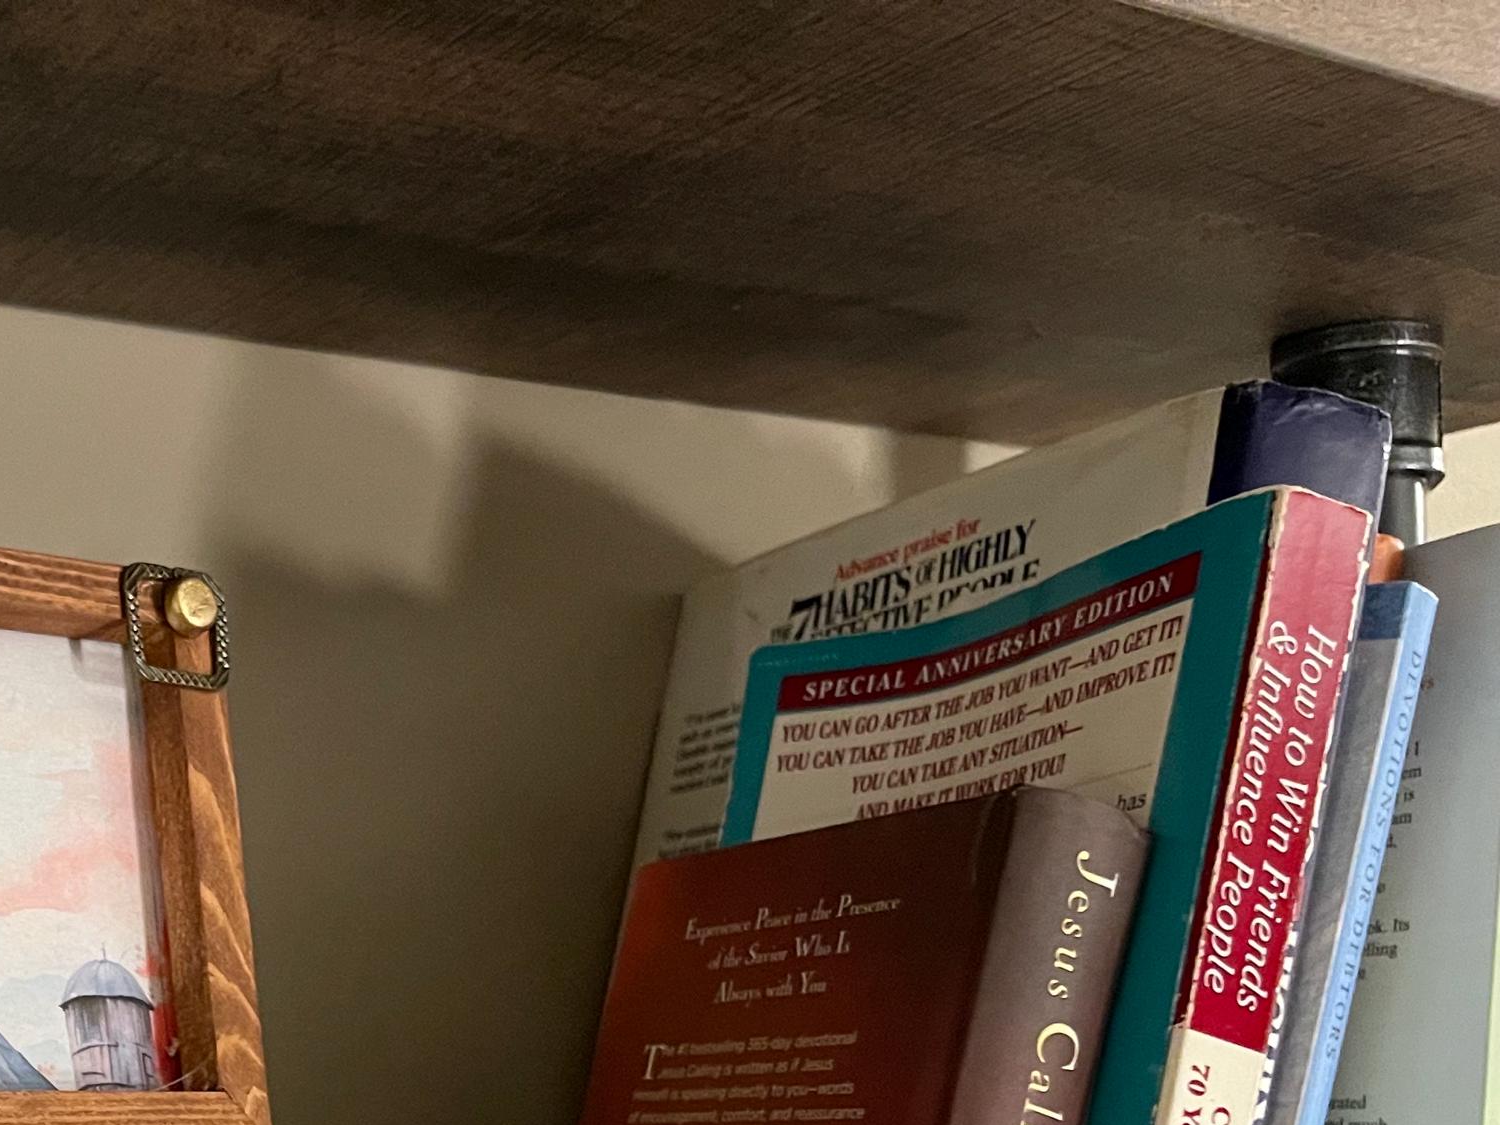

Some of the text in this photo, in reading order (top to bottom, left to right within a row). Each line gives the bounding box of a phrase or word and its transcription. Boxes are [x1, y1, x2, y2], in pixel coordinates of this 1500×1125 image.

[812, 565, 911, 629] HABITS
[938, 518, 1037, 585] HIGHLY
[835, 517, 982, 582] Advance praise for
[802, 570, 1174, 702] SPECIAL ANNIVERSARY EDITION
[1292, 624, 1338, 720] How
[776, 753, 811, 773] YOU
[812, 749, 845, 770] CAN
[849, 742, 891, 765] TAKE
[891, 735, 926, 757] THE
[924, 727, 957, 752] JOB
[958, 718, 989, 744] YOU
[1075, 660, 1150, 704] IMPROVE
[1150, 651, 1177, 679] IT!
[782, 722, 817, 744] YOU
[818, 718, 852, 739] CAN
[854, 714, 880, 736] GO
[880, 704, 932, 732] AFTER
[934, 694, 966, 716] THE
[964, 685, 996, 711] JOB
[998, 673, 1028, 701] YOU
[1122, 624, 1158, 653] GET
[1158, 614, 1184, 642] IT!
[851, 773, 886, 795] YOU
[886, 767, 918, 789] CAN
[920, 755, 957, 782] TAKE
[957, 746, 990, 773] ANY
[1284, 725, 1315, 767] to
[855, 752, 1067, 821] AND MAKE IT WORK FOR YOU!
[1116, 793, 1148, 812] has
[1202, 620, 1299, 995] & Influence People
[1266, 777, 1310, 855] Win
[793, 906, 808, 925] in
[810, 898, 833, 922] the
[835, 893, 902, 919] Presence
[794, 933, 832, 958] Who
[835, 929, 851, 954] Is
[1046, 849, 1120, 1001] Jesus
[1236, 858, 1292, 1013] Friends
[799, 970, 828, 995] You
[1186, 1063, 1211, 1096] 70
